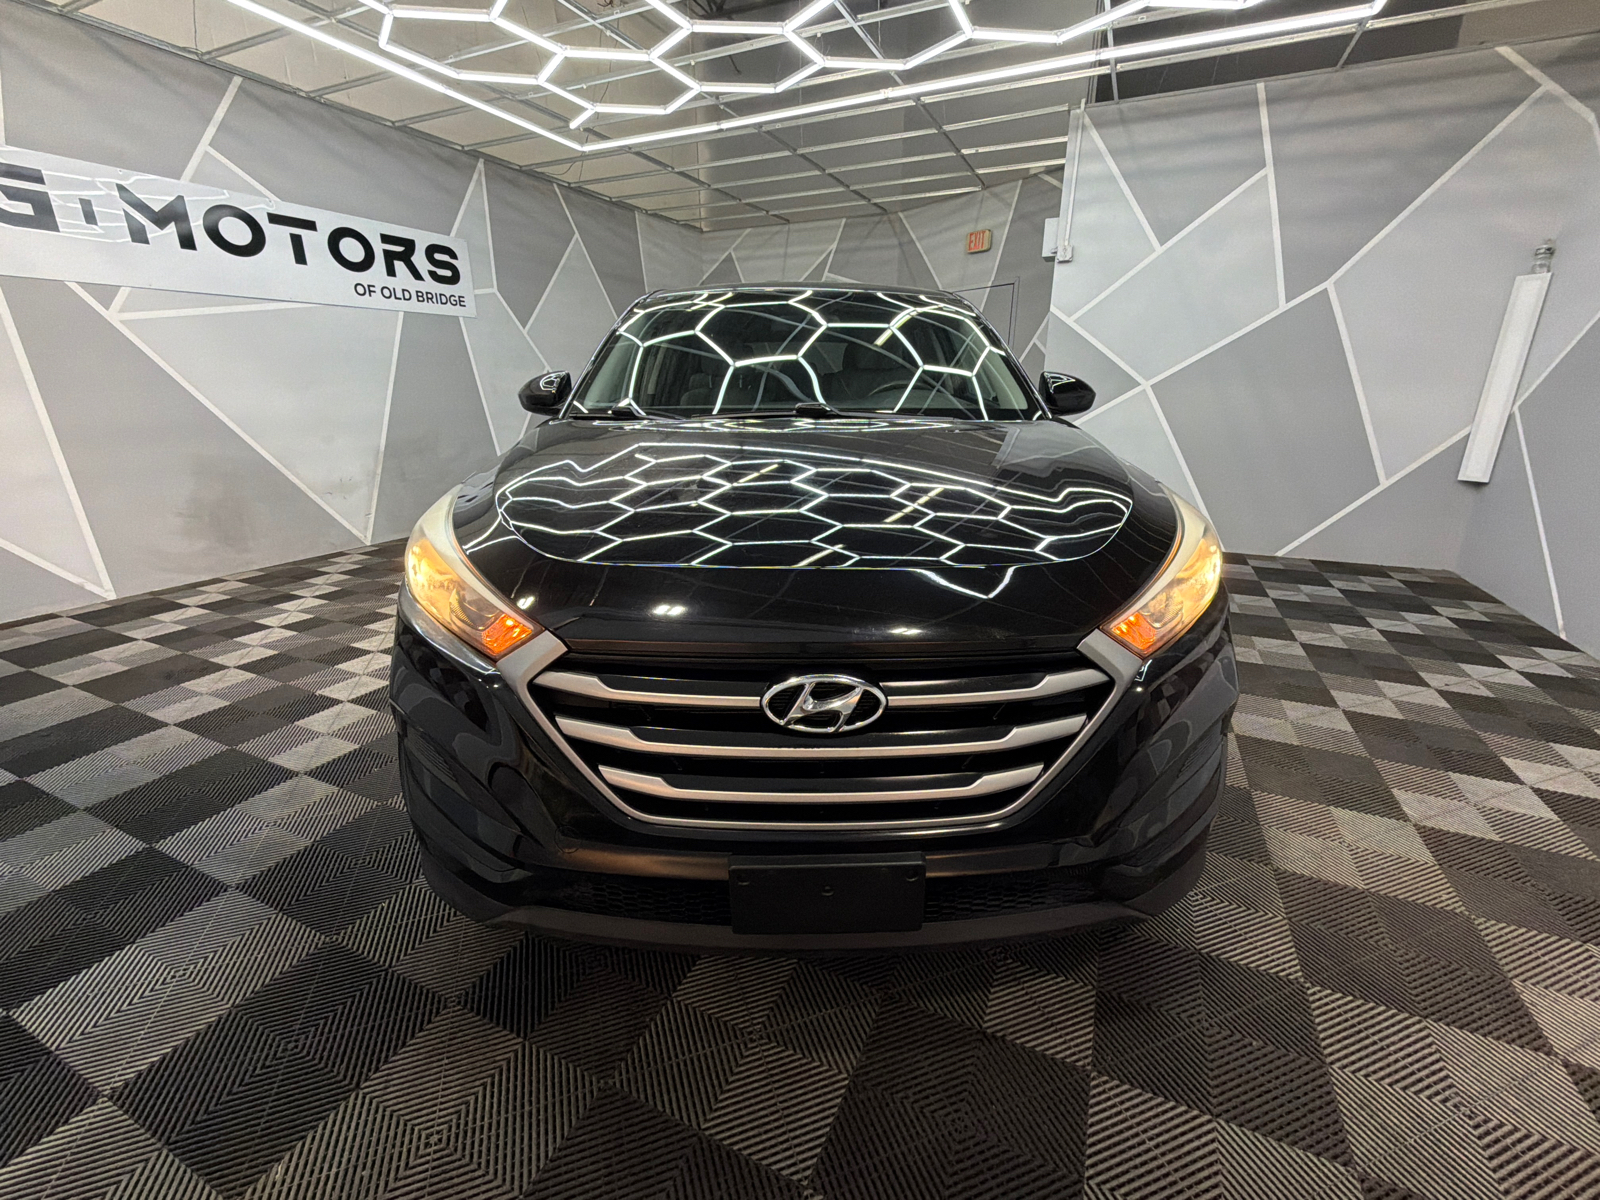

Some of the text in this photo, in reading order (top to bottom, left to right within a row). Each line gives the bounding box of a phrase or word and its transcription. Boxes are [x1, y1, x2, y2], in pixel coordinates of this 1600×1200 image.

[115, 183, 461, 285] MOTORS
[968, 230, 986, 251] EXIT
[354, 282, 467, 308] OF OLD BRIDGE
